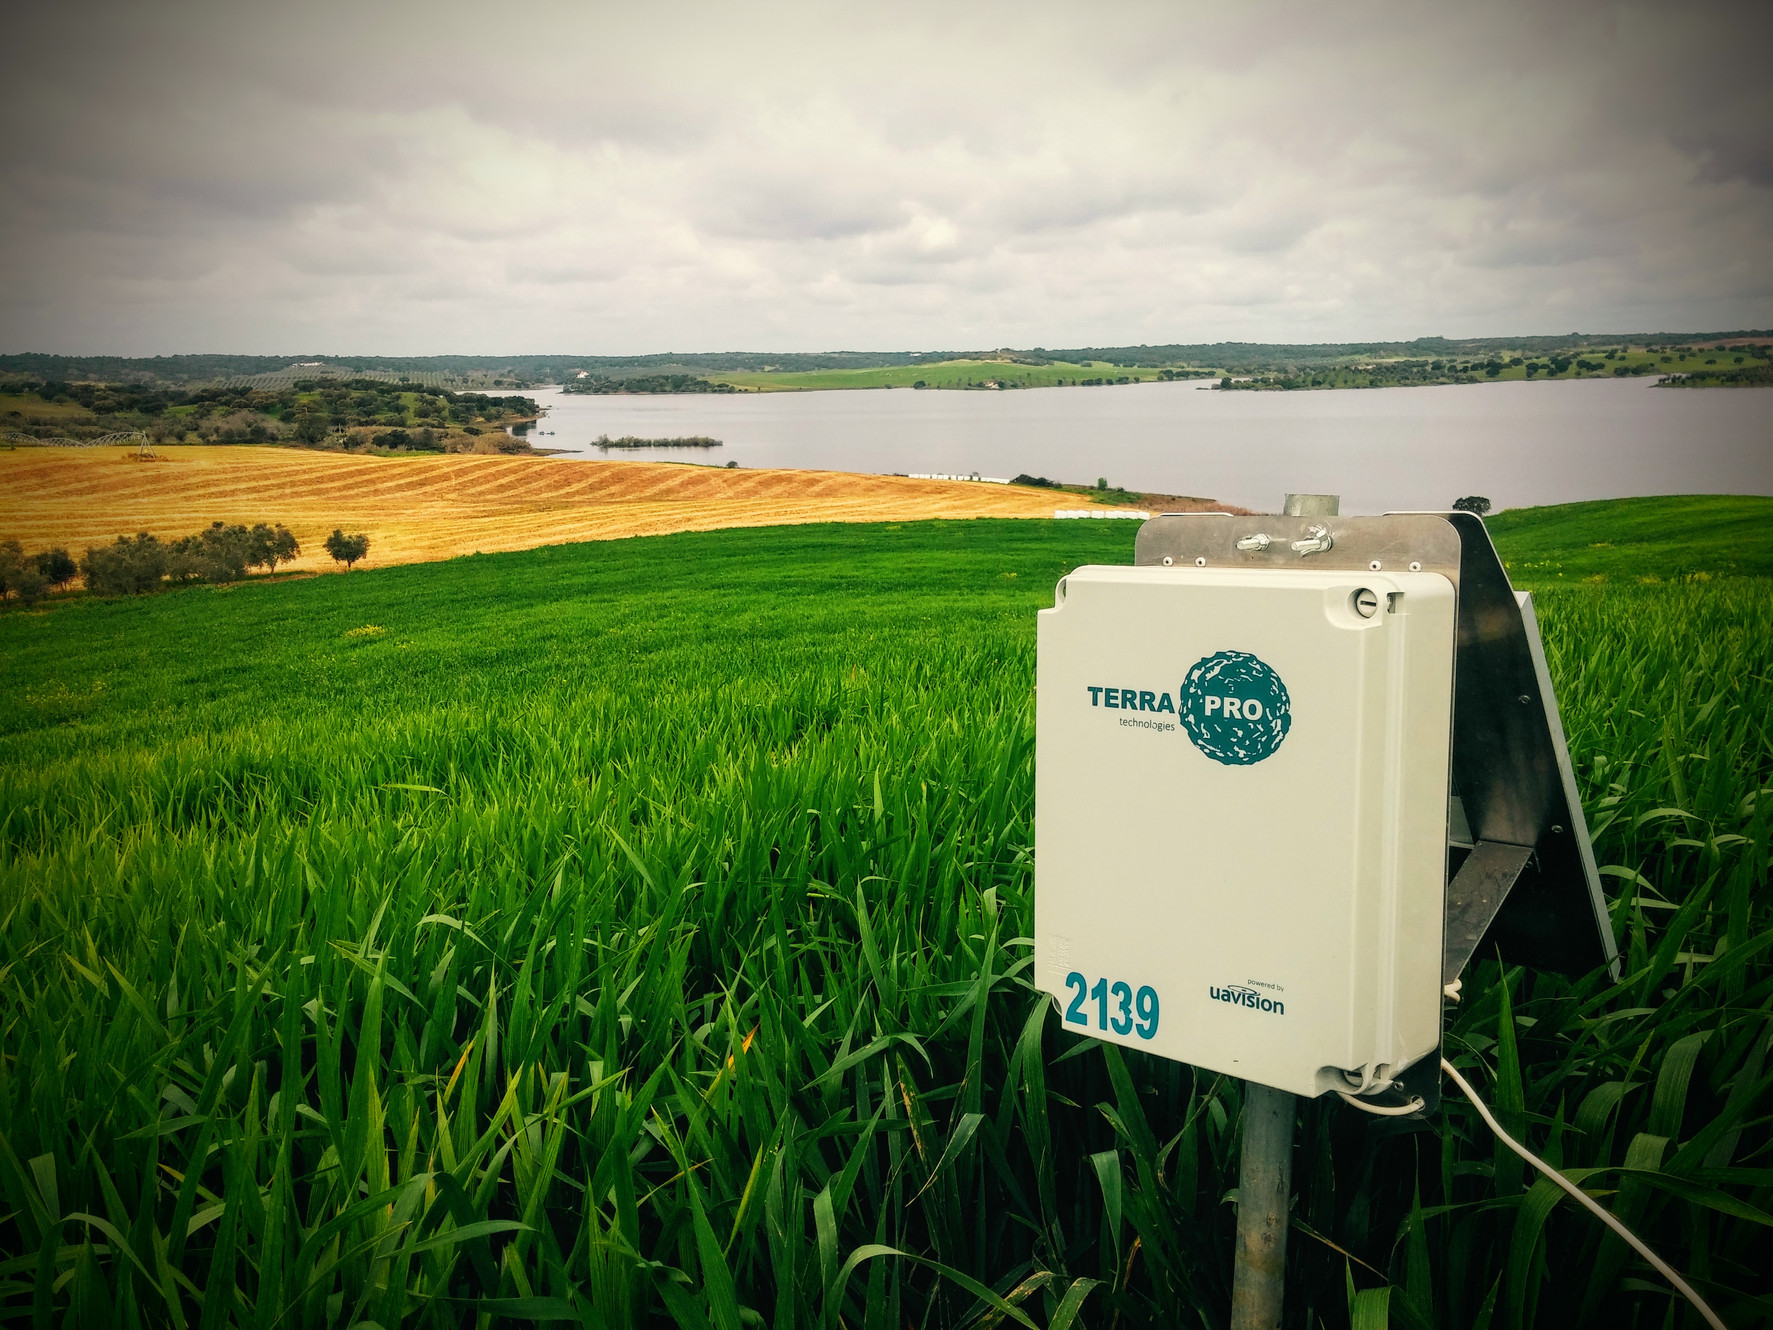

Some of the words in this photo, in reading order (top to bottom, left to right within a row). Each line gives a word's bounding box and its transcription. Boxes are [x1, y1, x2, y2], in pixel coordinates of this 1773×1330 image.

[1087, 686, 1176, 714] TERRA
[1204, 695, 1263, 721] PRO
[1119, 717, 1176, 732] technologies
[1247, 979, 1275, 990] powered
[1276, 984, 1285, 992] by
[1065, 971, 1160, 1040] 2139
[1209, 986, 1285, 1015] uavision
